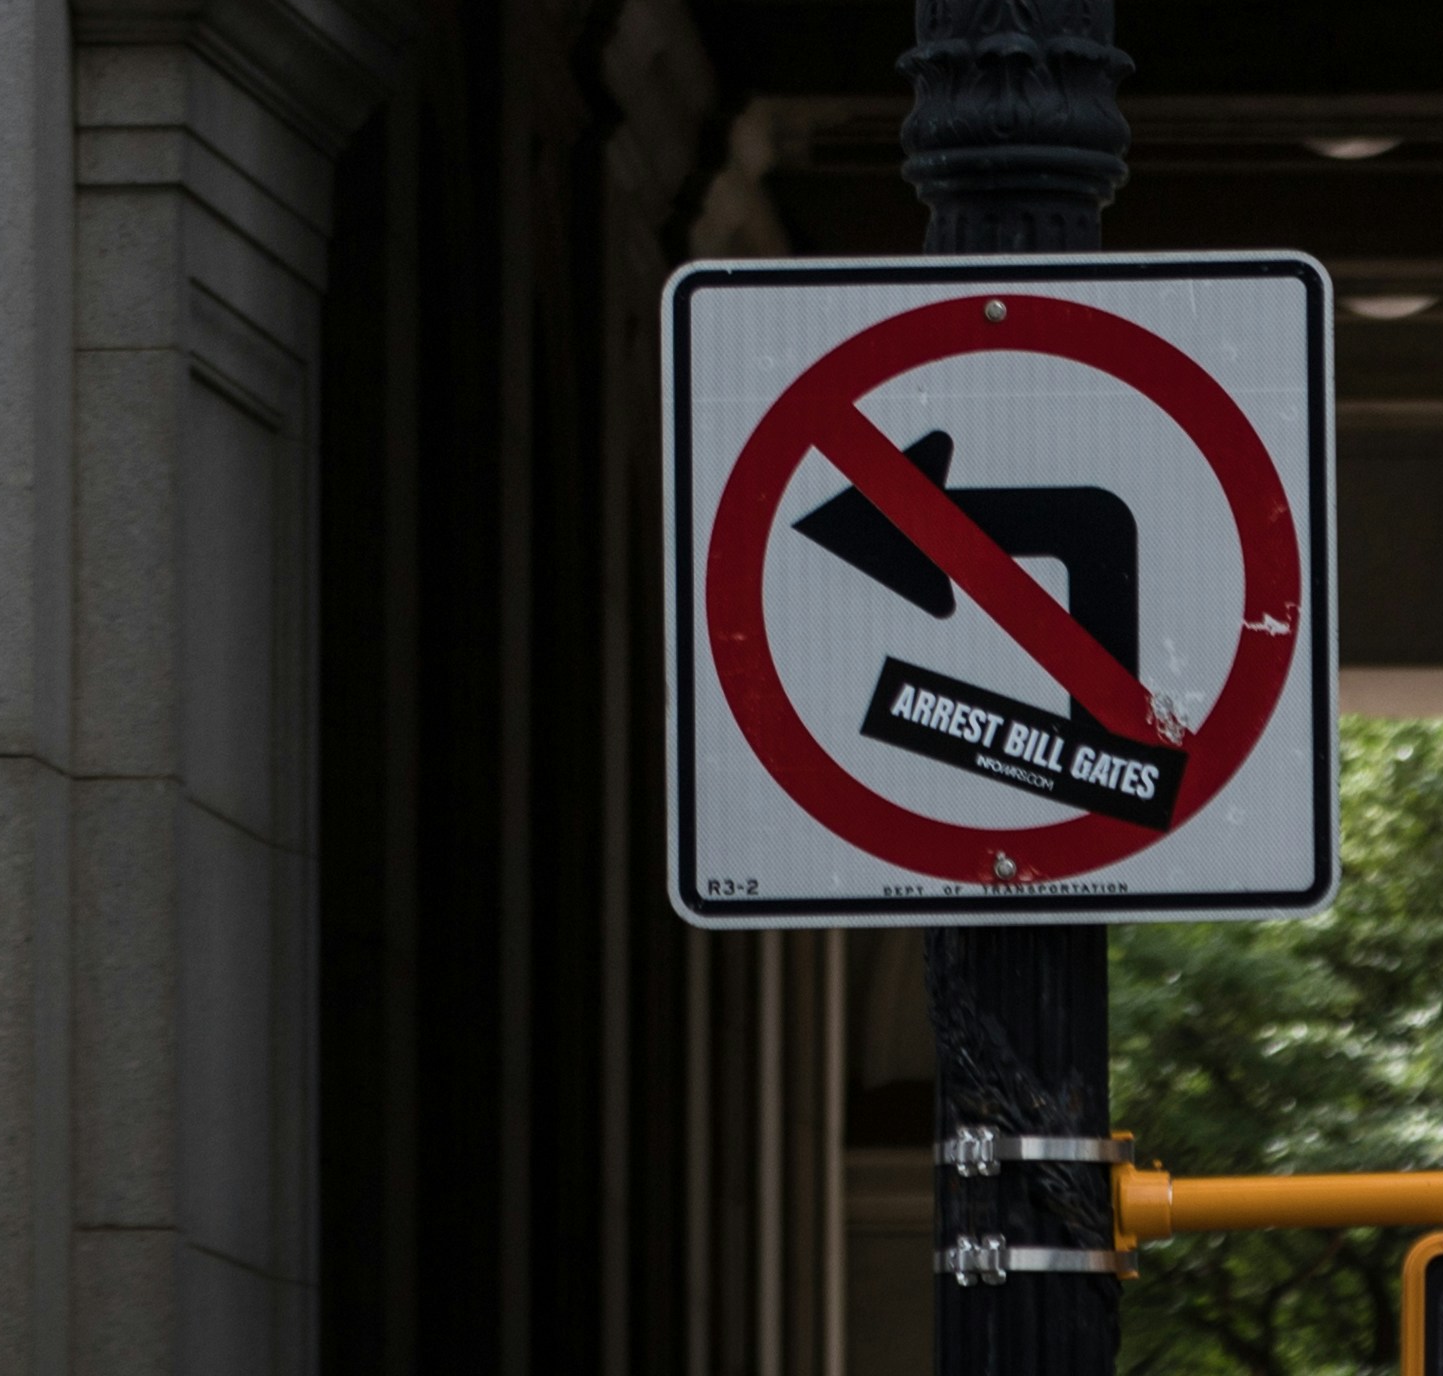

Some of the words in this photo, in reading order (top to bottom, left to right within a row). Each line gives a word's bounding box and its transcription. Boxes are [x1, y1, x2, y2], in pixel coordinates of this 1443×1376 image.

[891, 683, 1004, 748] ARREST
[1003, 719, 1065, 773] BILL
[1070, 745, 1159, 799] GATES
[707, 878, 759, 896] R3-2
[883, 885, 924, 897] DEPT
[943, 885, 962, 895] OF
[982, 883, 1129, 896] TRANSPORTATION
